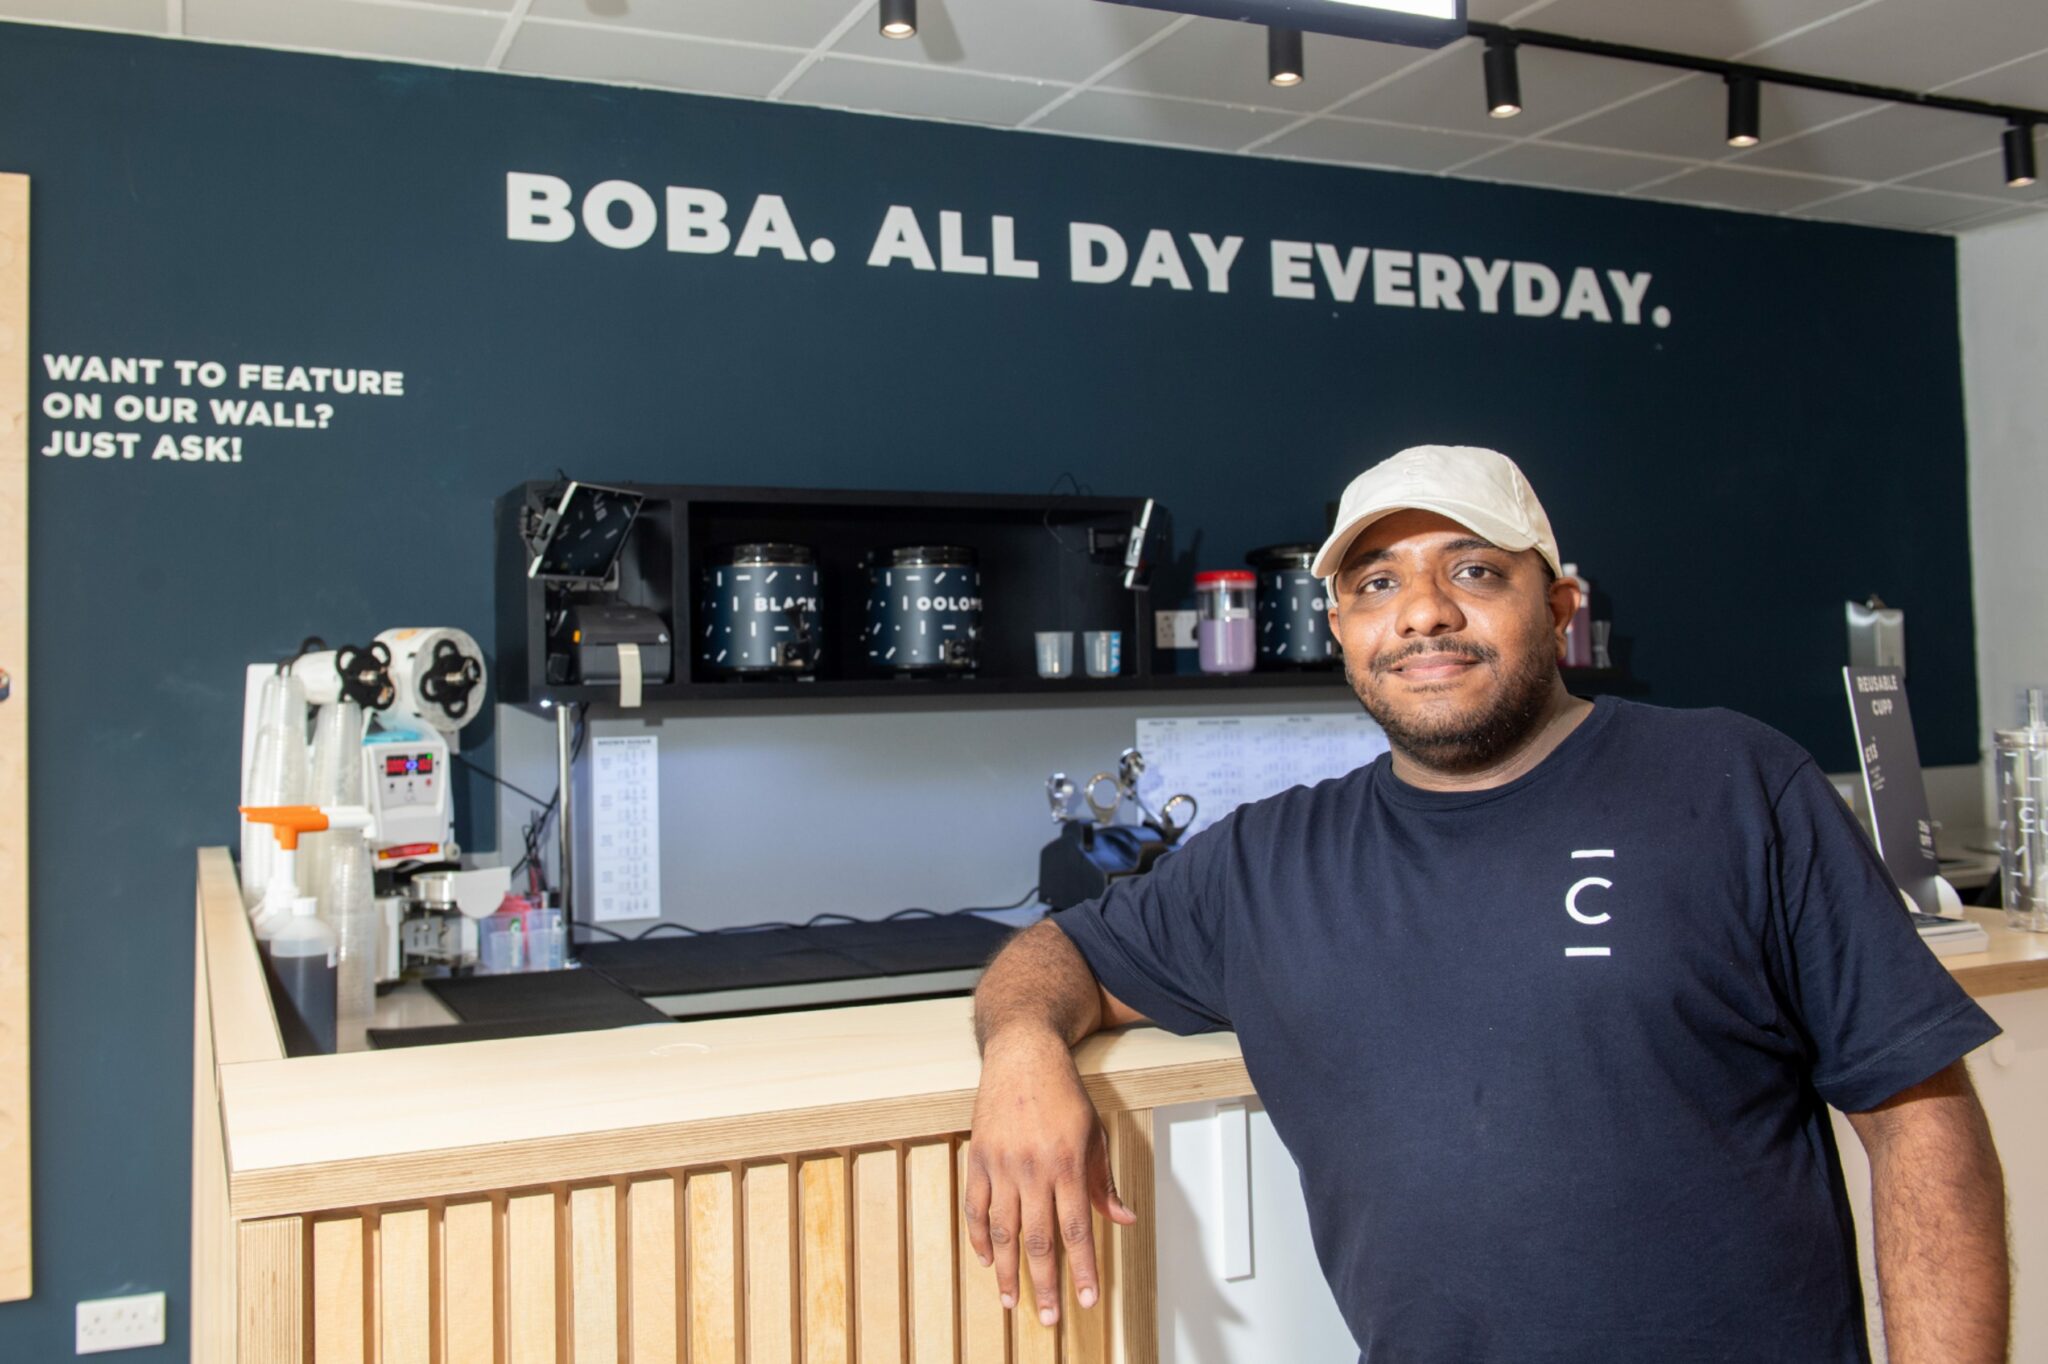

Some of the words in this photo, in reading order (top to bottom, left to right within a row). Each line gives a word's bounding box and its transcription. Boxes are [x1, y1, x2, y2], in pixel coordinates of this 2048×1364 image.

[506, 171, 836, 264] BOBA.
[867, 205, 1039, 279] ALL
[1069, 222, 1244, 293] DAY
[1271, 240, 1671, 326] EVERYDAY.
[42, 353, 164, 385] WANT
[174, 359, 227, 388] TO
[238, 363, 405, 396] FEATURE
[42, 391, 102, 420] ON
[114, 394, 198, 424] OUR
[209, 398, 335, 429] WALL?
[41, 430, 141, 459] JUST
[151, 434, 243, 463] ASK!
[1856, 674, 1898, 693] REUSABLE
